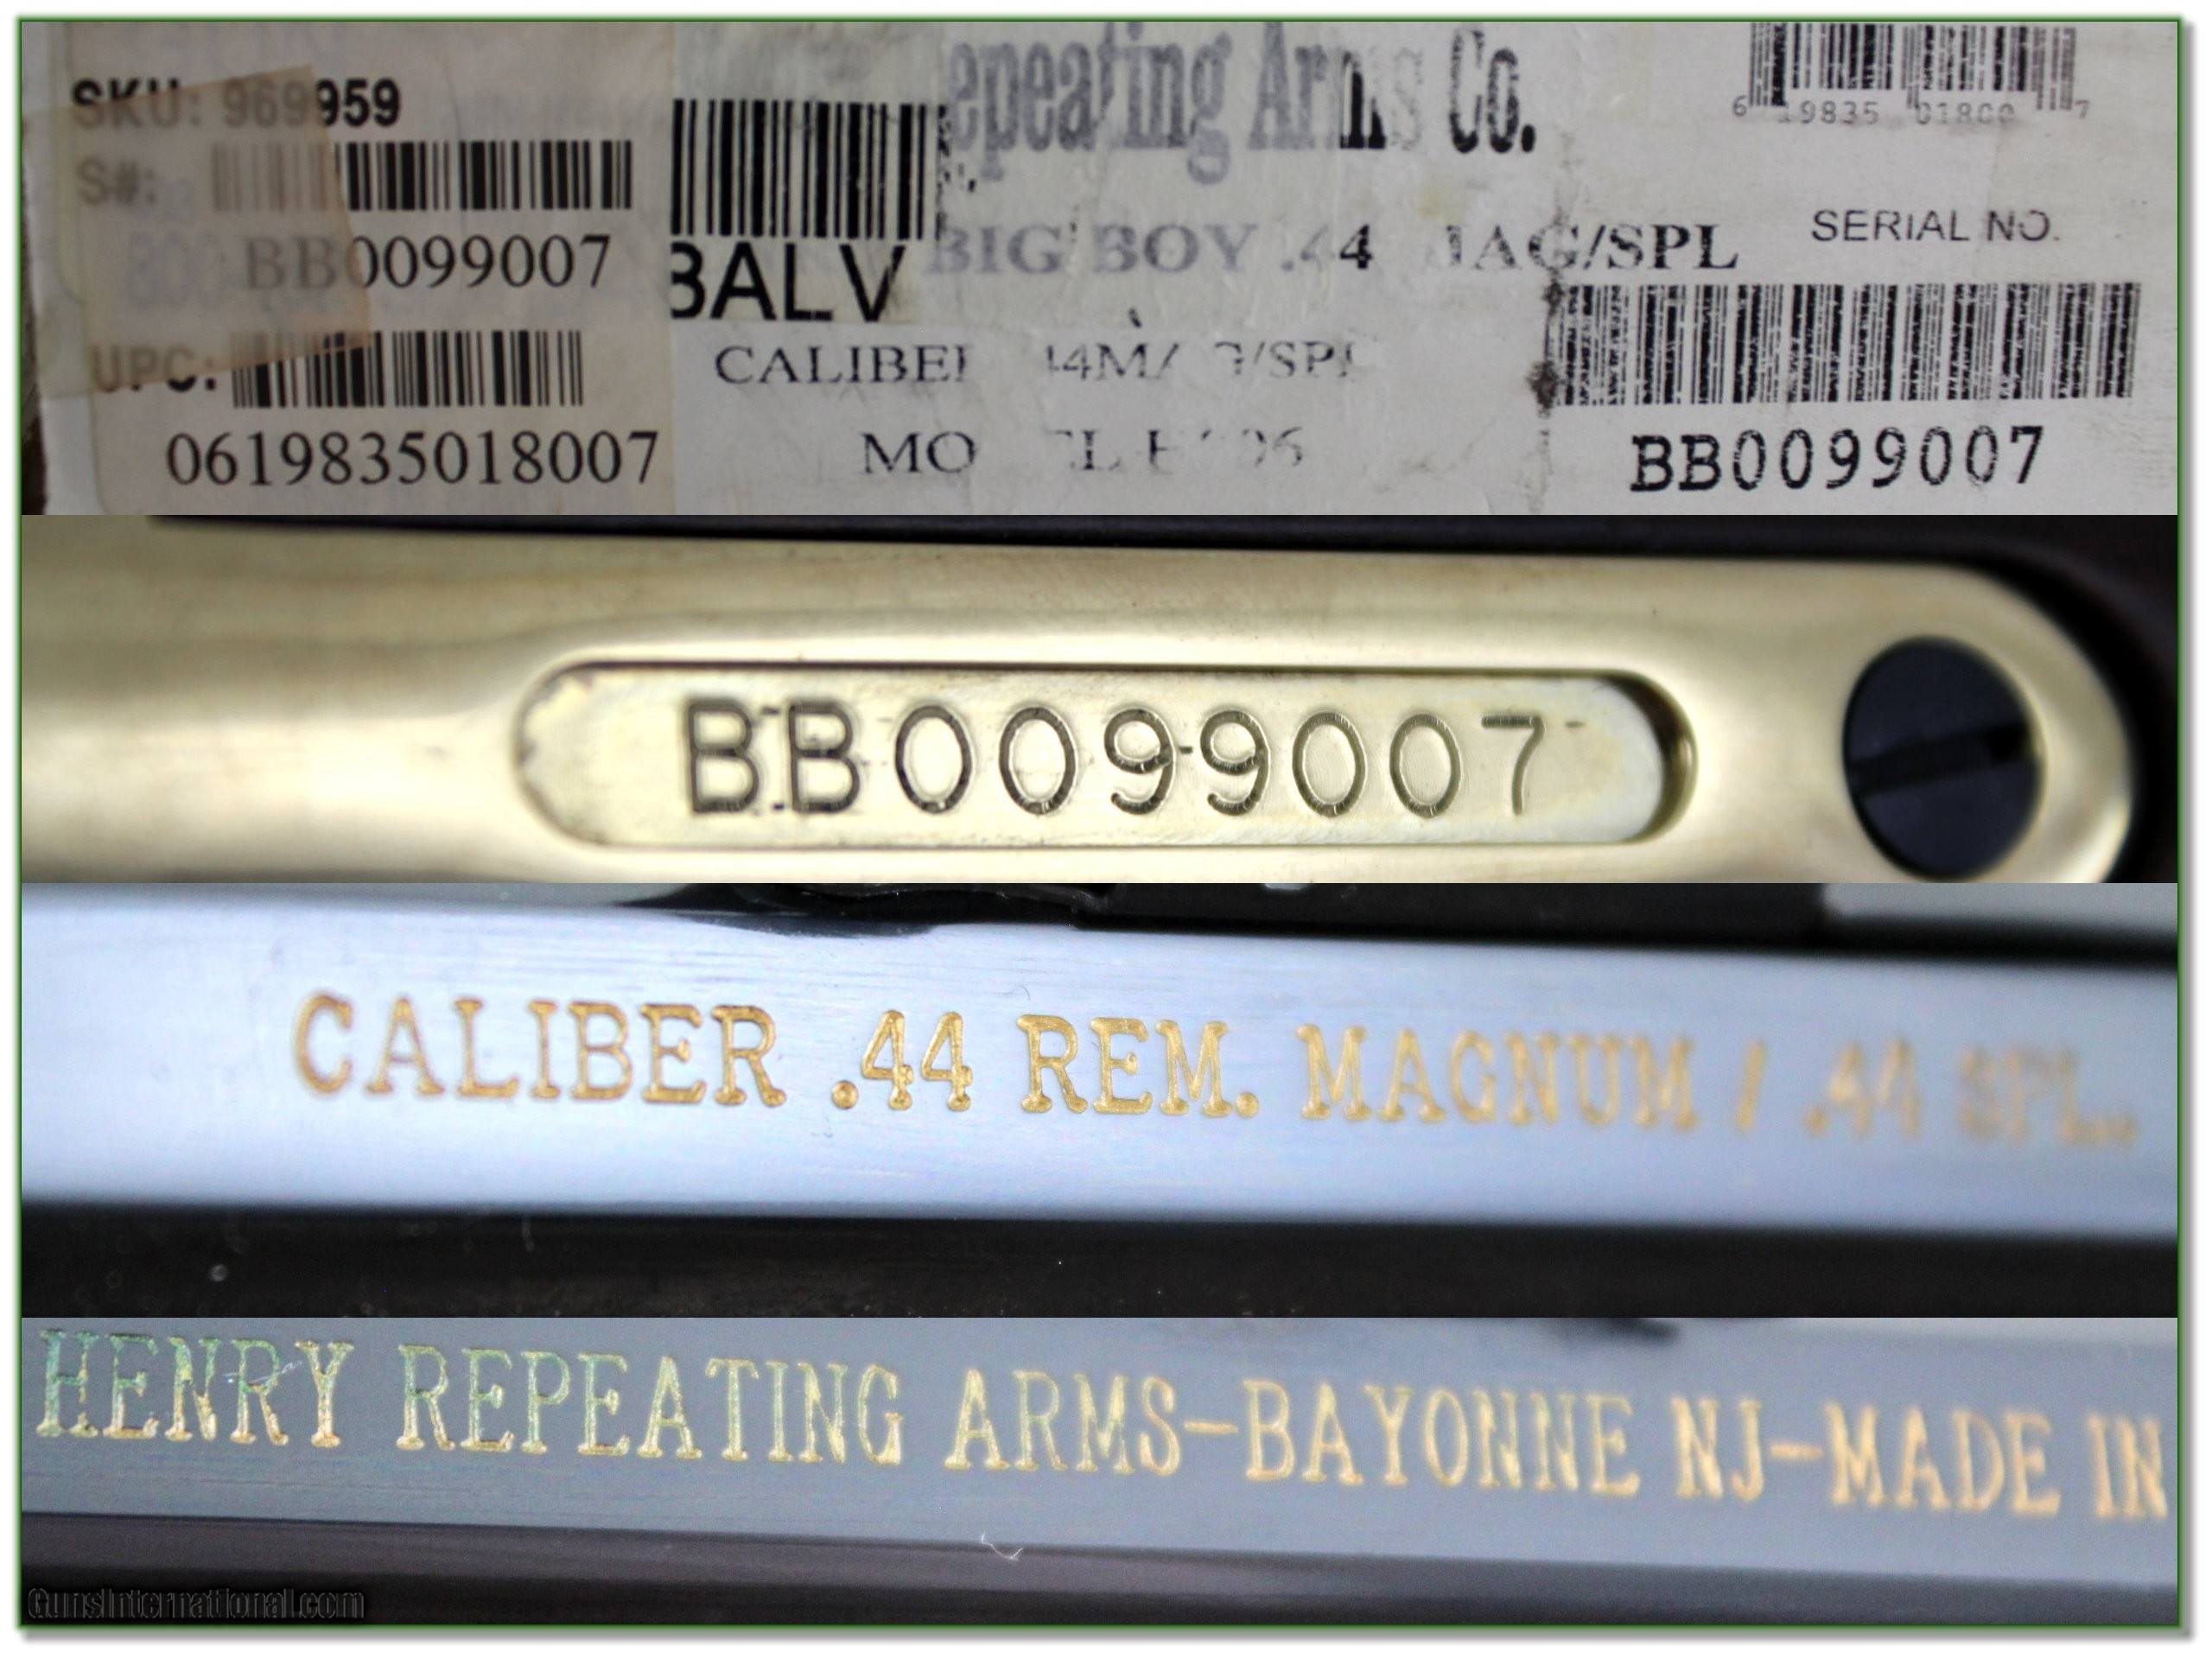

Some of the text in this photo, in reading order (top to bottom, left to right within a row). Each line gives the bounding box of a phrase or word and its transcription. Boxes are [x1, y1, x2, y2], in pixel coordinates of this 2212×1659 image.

[71, 76, 400, 129] SKU: 969959
[1449, 24, 1537, 154] Co.
[1090, 223, 1258, 273] BOY
[1811, 208, 2062, 243] SERIAL NO.
[244, 234, 613, 289] BB0099007
[92, 342, 217, 393] UPC:
[166, 429, 659, 486] 0619835018007
[1630, 424, 2044, 493] BB0099007
[686, 695, 1545, 817] BB0099007
[290, 990, 787, 1109] CALIBER
[831, 1009, 974, 1113] .44
[1016, 1014, 1261, 1122] REM.
[1296, 1022, 1700, 1134] MAGNUM
[1804, 1036, 1922, 1142] .44
[1956, 1042, 2141, 1147] SPL.
[36, 1328, 355, 1449] HENRY
[396, 1342, 906, 1468] REPEATING
[2086, 1412, 2169, 1520] IN
